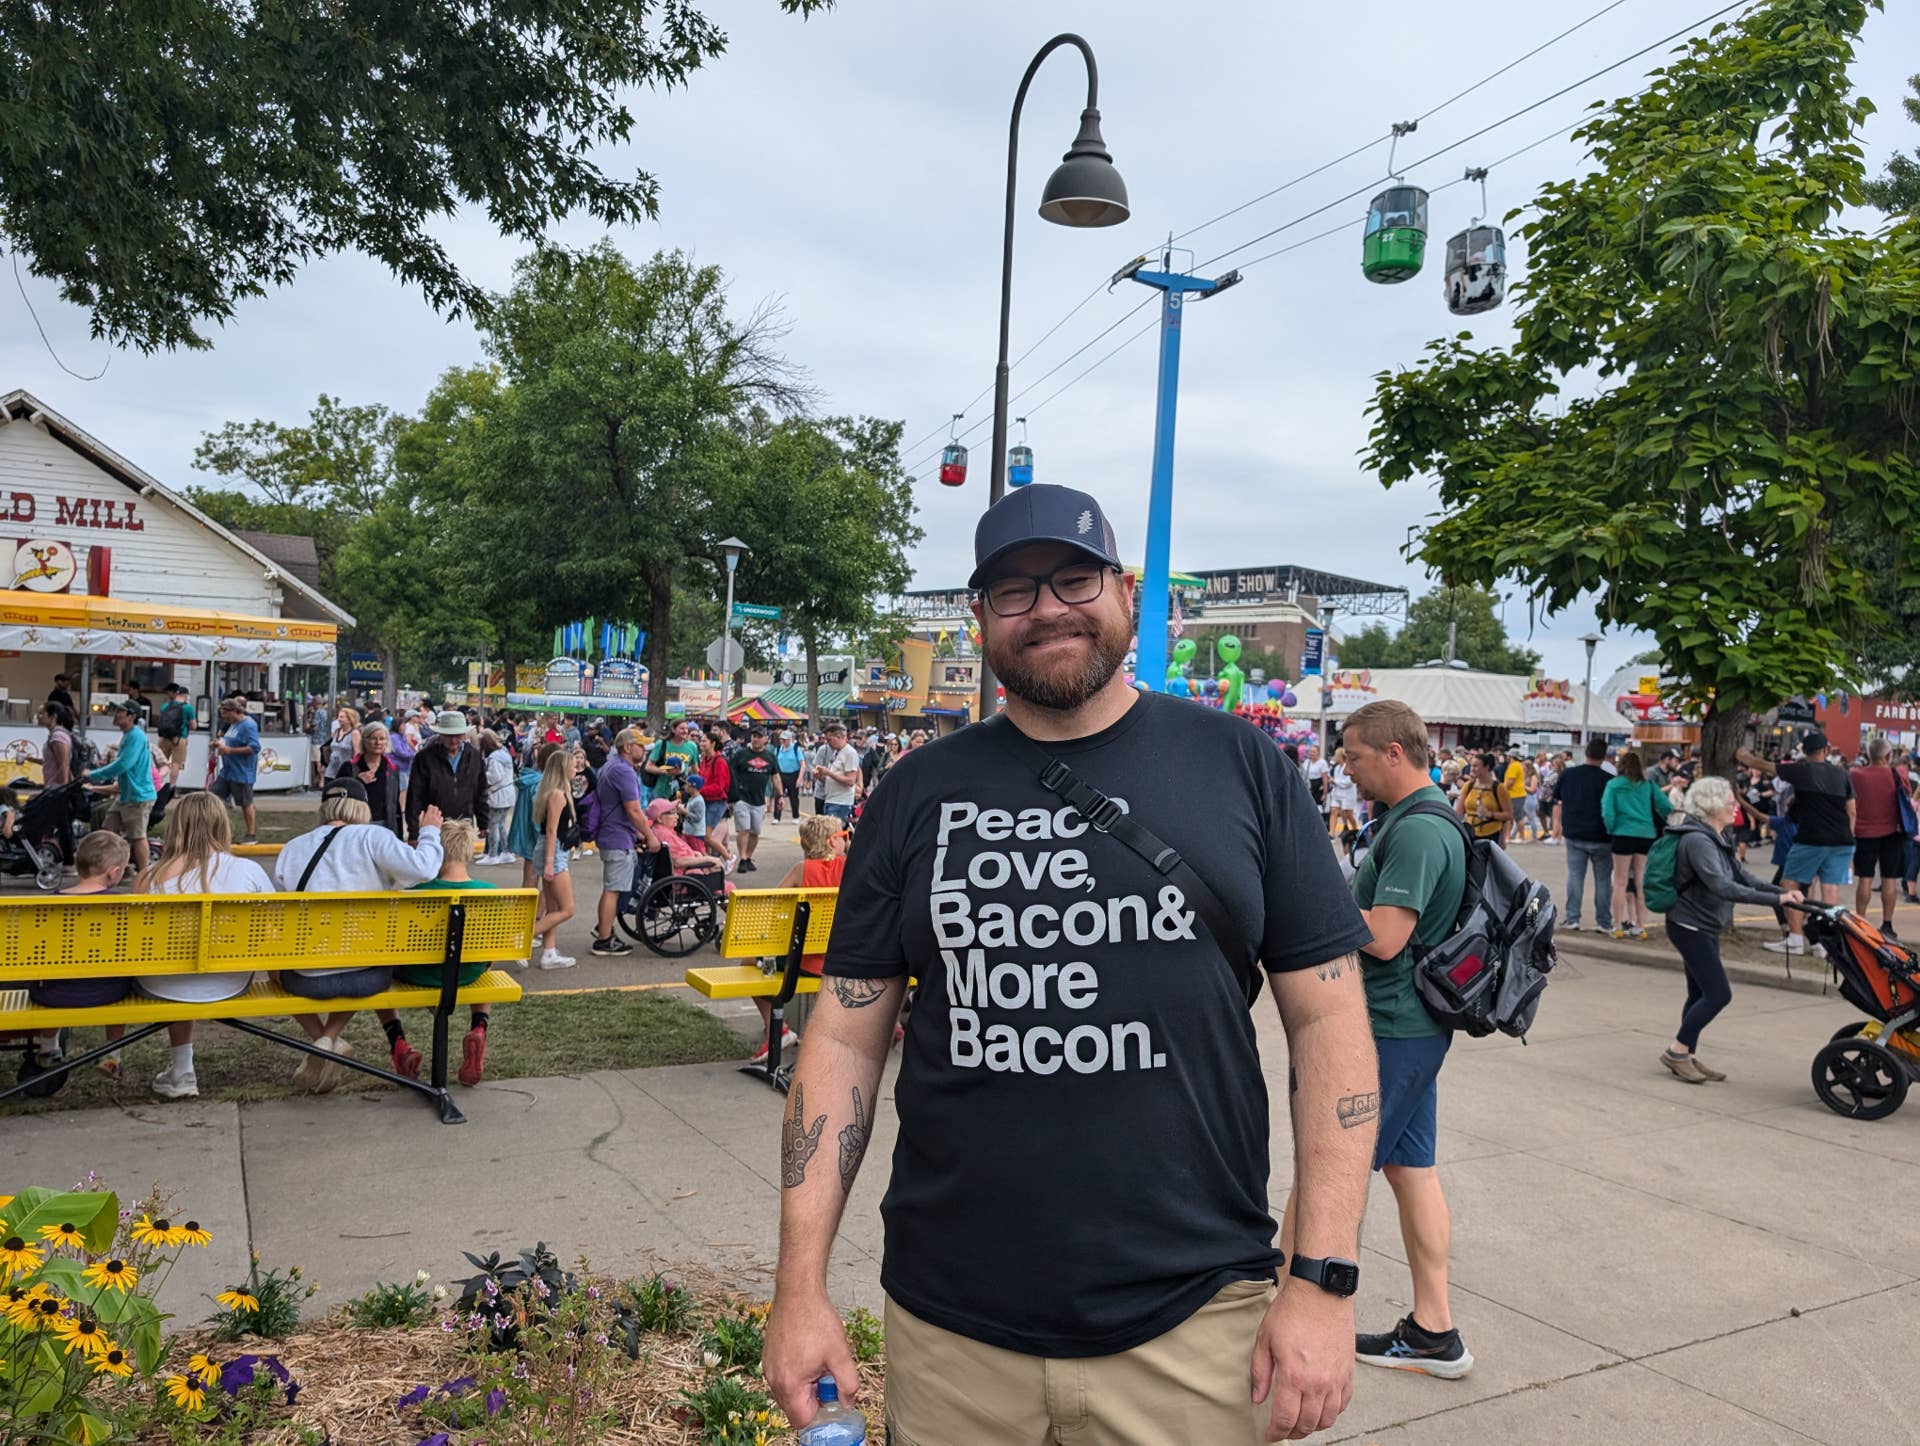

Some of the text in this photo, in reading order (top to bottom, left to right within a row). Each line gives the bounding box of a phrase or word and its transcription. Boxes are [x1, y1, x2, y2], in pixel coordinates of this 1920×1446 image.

[1169, 292, 1181, 309] 5
[55, 495, 144, 531] MILL
[1238, 574, 1275, 592] SHOW
[795, 674, 807, 683] BAK
[1876, 705, 1906, 719] FARM
[937, 797, 1129, 846] Peac
[931, 847, 1096, 893] Love,
[940, 949, 1099, 1010] More
[949, 1007, 1167, 1075] Bacon.
